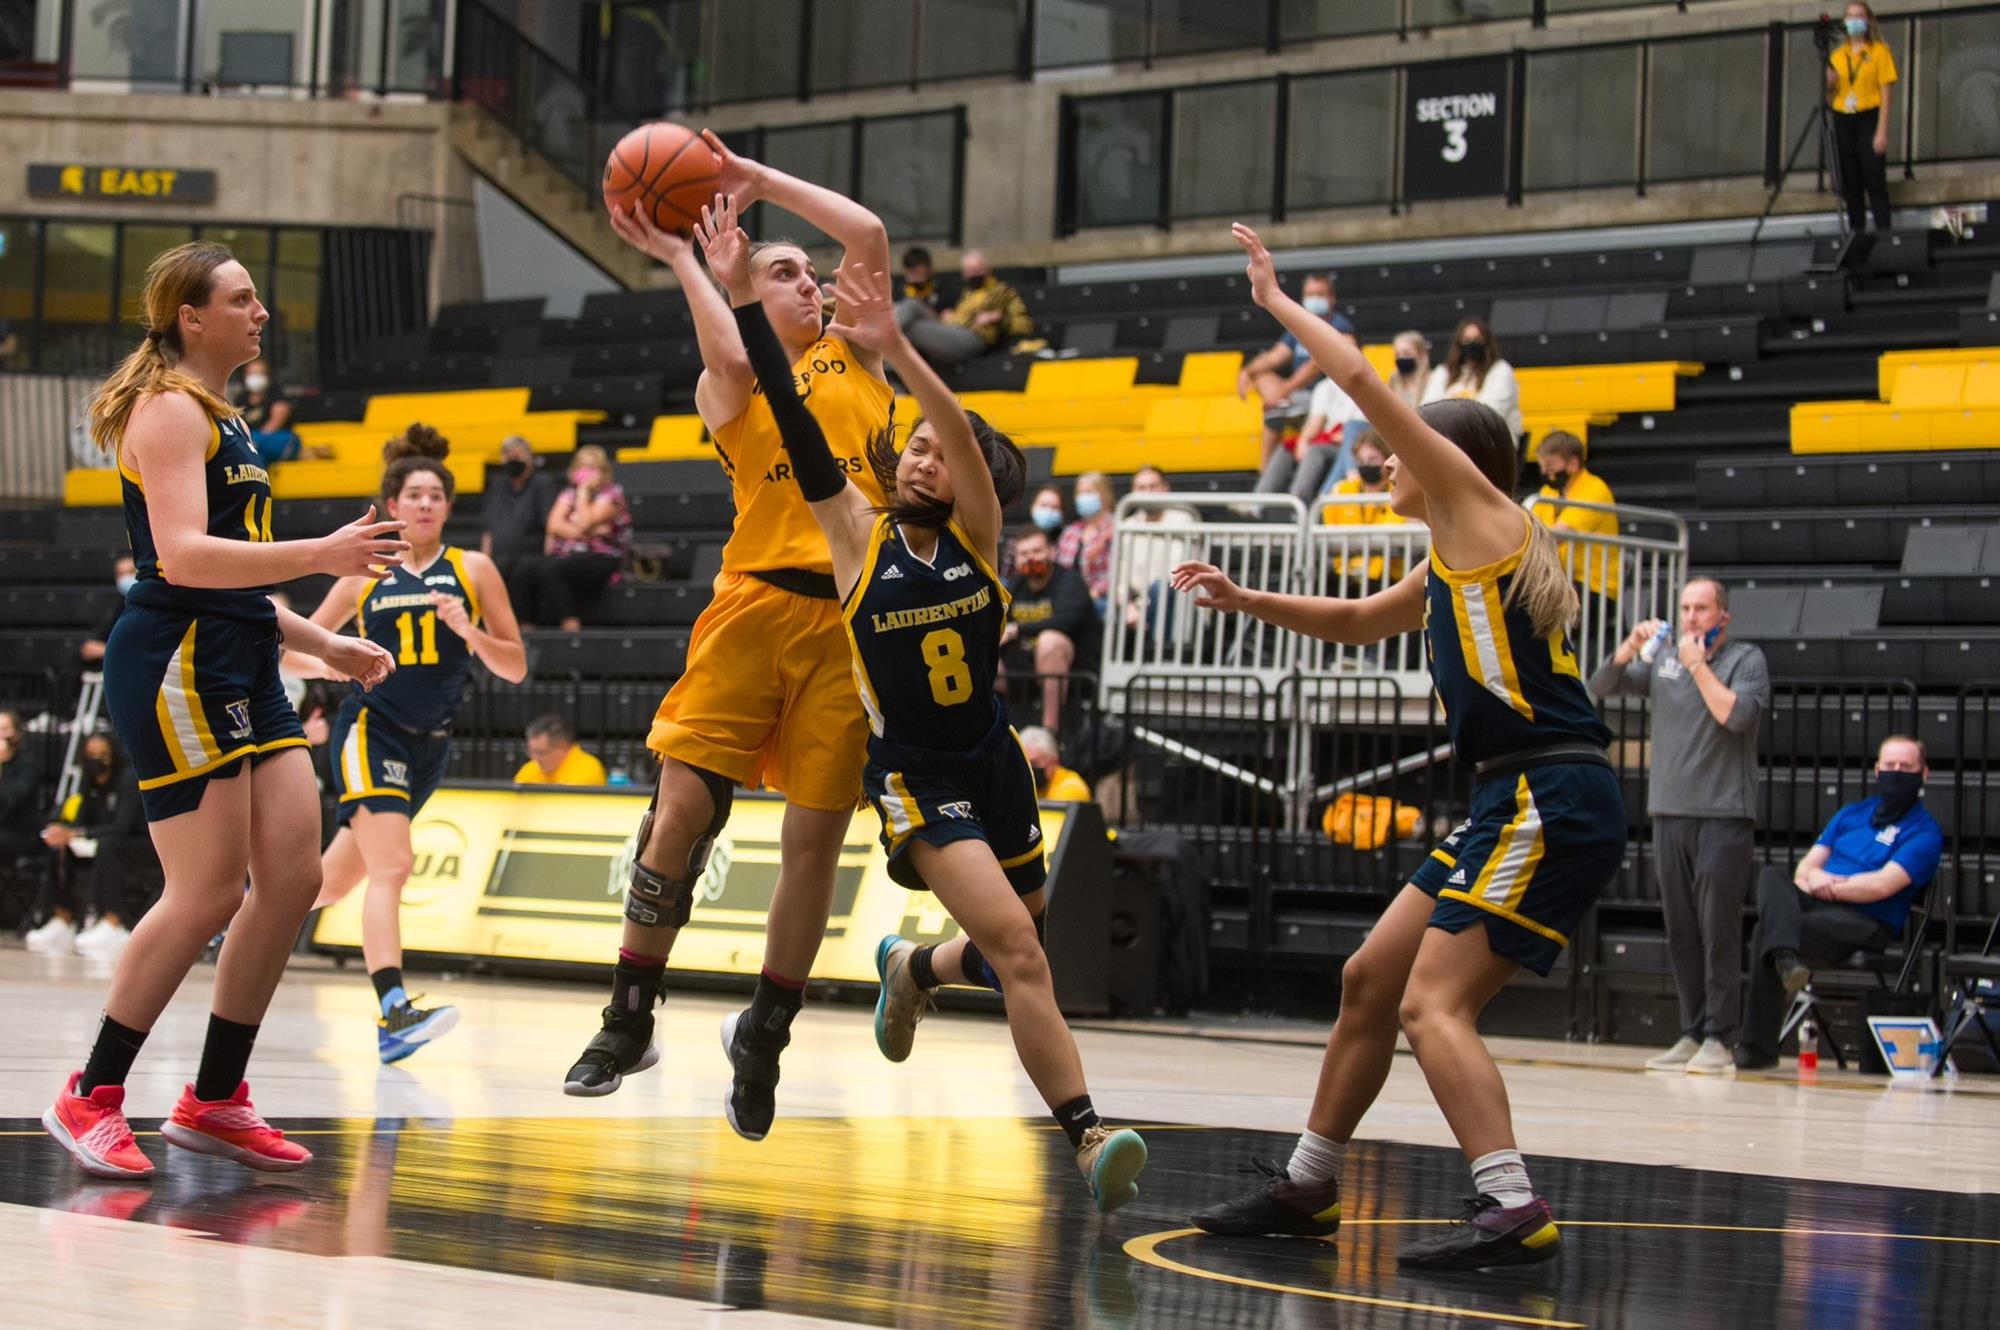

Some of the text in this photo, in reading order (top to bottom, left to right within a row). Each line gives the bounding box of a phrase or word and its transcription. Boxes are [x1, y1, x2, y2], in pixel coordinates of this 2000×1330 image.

[1416, 92, 1496, 122] SECTION
[1442, 119, 1468, 162] 3
[100, 168, 176, 196] EAST
[872, 586, 991, 633] LAURENTIAN
[395, 610, 439, 665] 11
[920, 628, 973, 706] 8
[410, 853, 460, 878] UA
